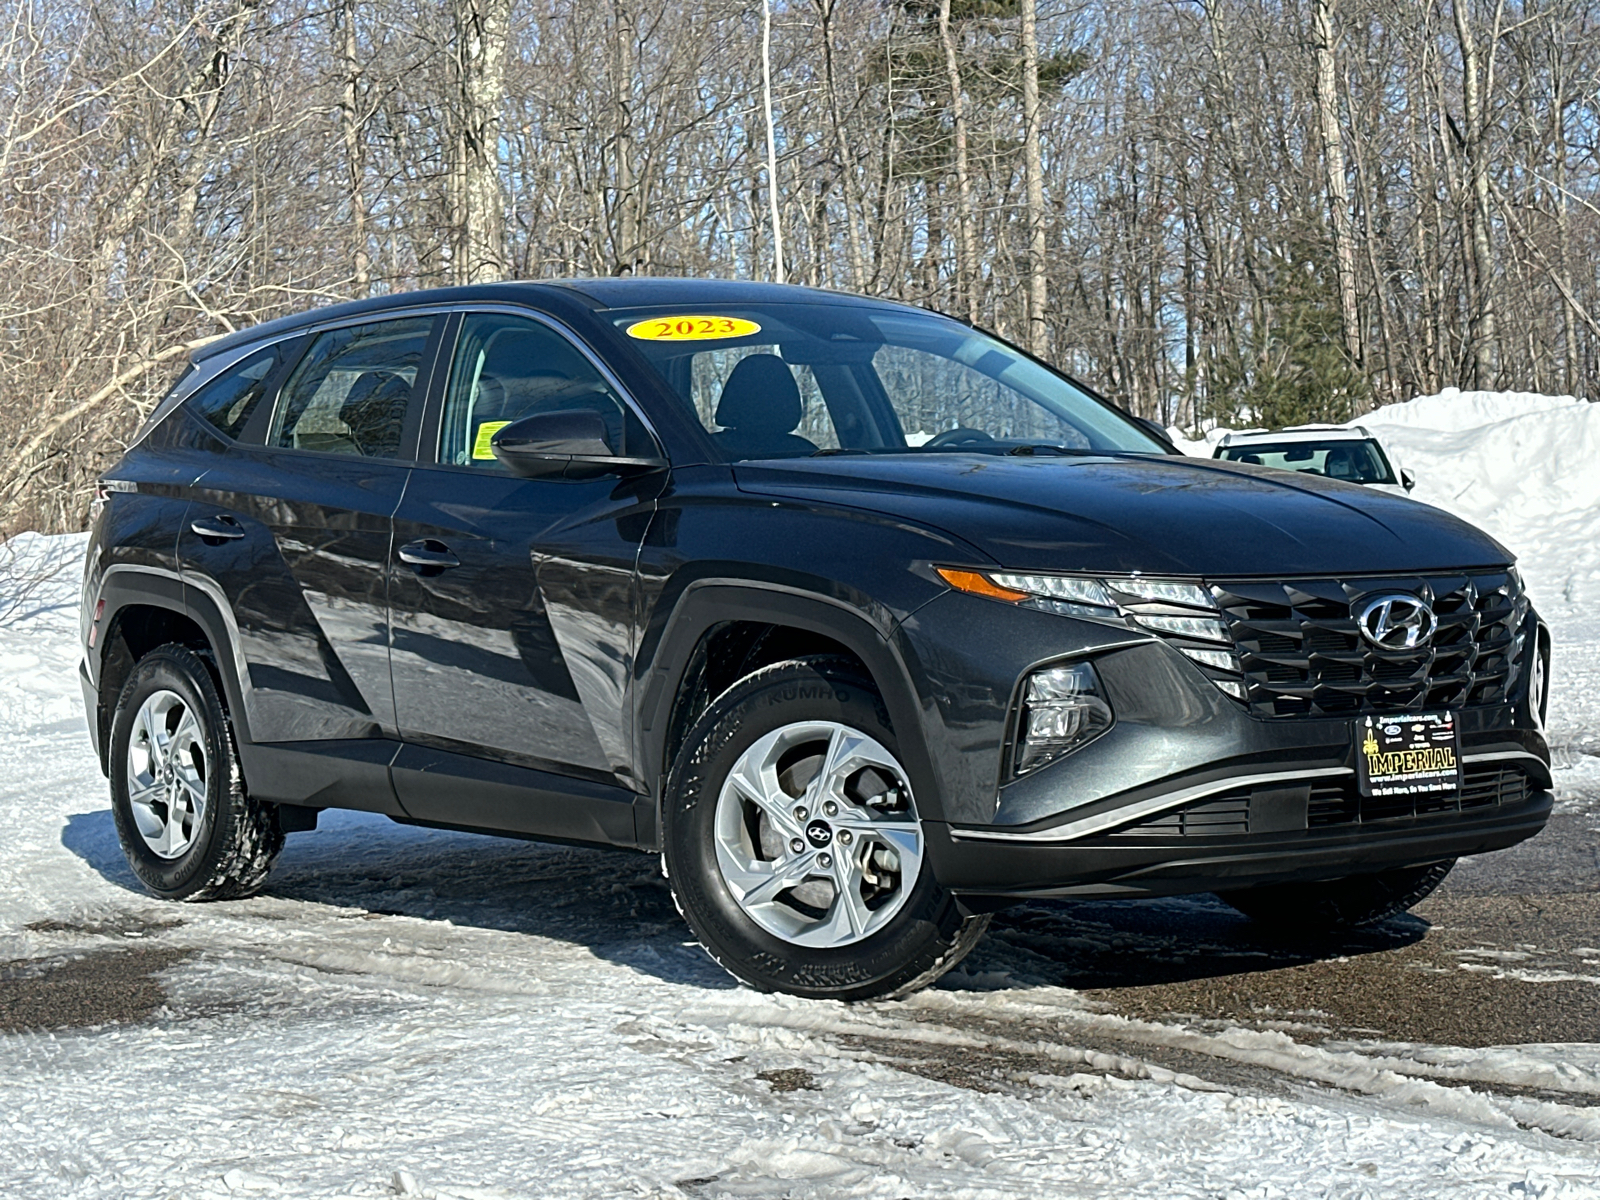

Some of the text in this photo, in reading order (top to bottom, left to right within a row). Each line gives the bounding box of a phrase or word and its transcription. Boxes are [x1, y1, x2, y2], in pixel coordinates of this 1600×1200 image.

[654, 319, 736, 337] 2023
[766, 686, 850, 706] KUMHO
[1379, 715, 1438, 724] Imperialcars.com
[1368, 747, 1456, 776] IMPERIAL
[1369, 769, 1457, 783] www.imperialcars.com
